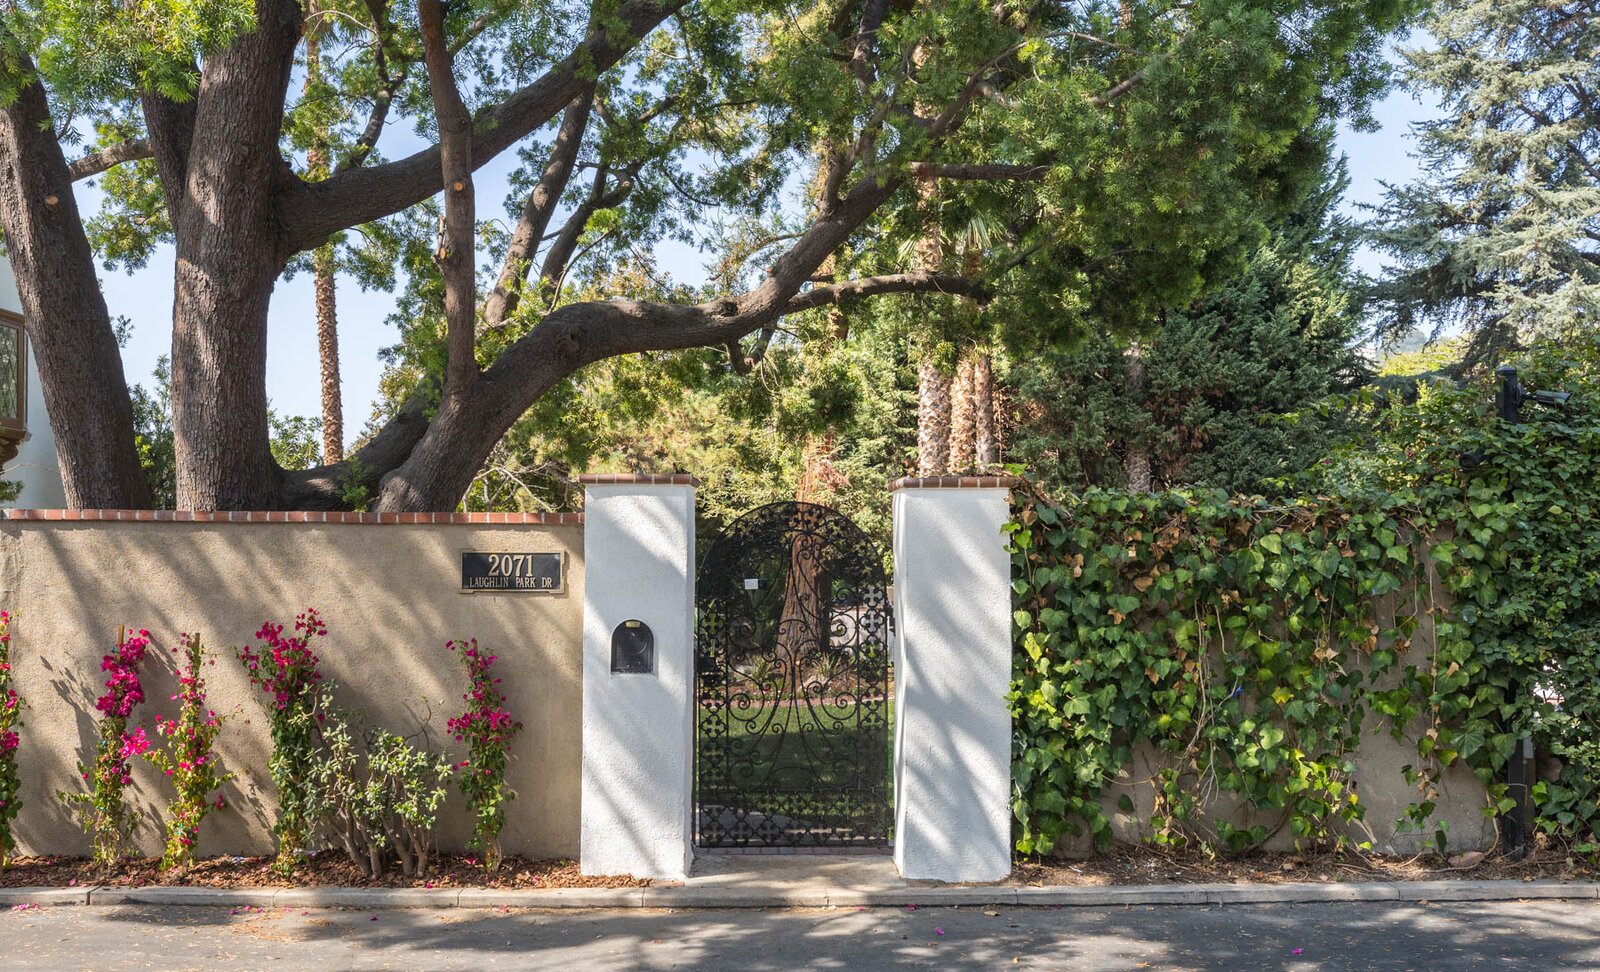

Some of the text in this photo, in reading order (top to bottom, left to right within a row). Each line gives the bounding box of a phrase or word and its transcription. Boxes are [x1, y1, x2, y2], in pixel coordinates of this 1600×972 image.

[488, 554, 533, 577] 2071
[469, 577, 553, 588] LAUGHLIN PARK DR
